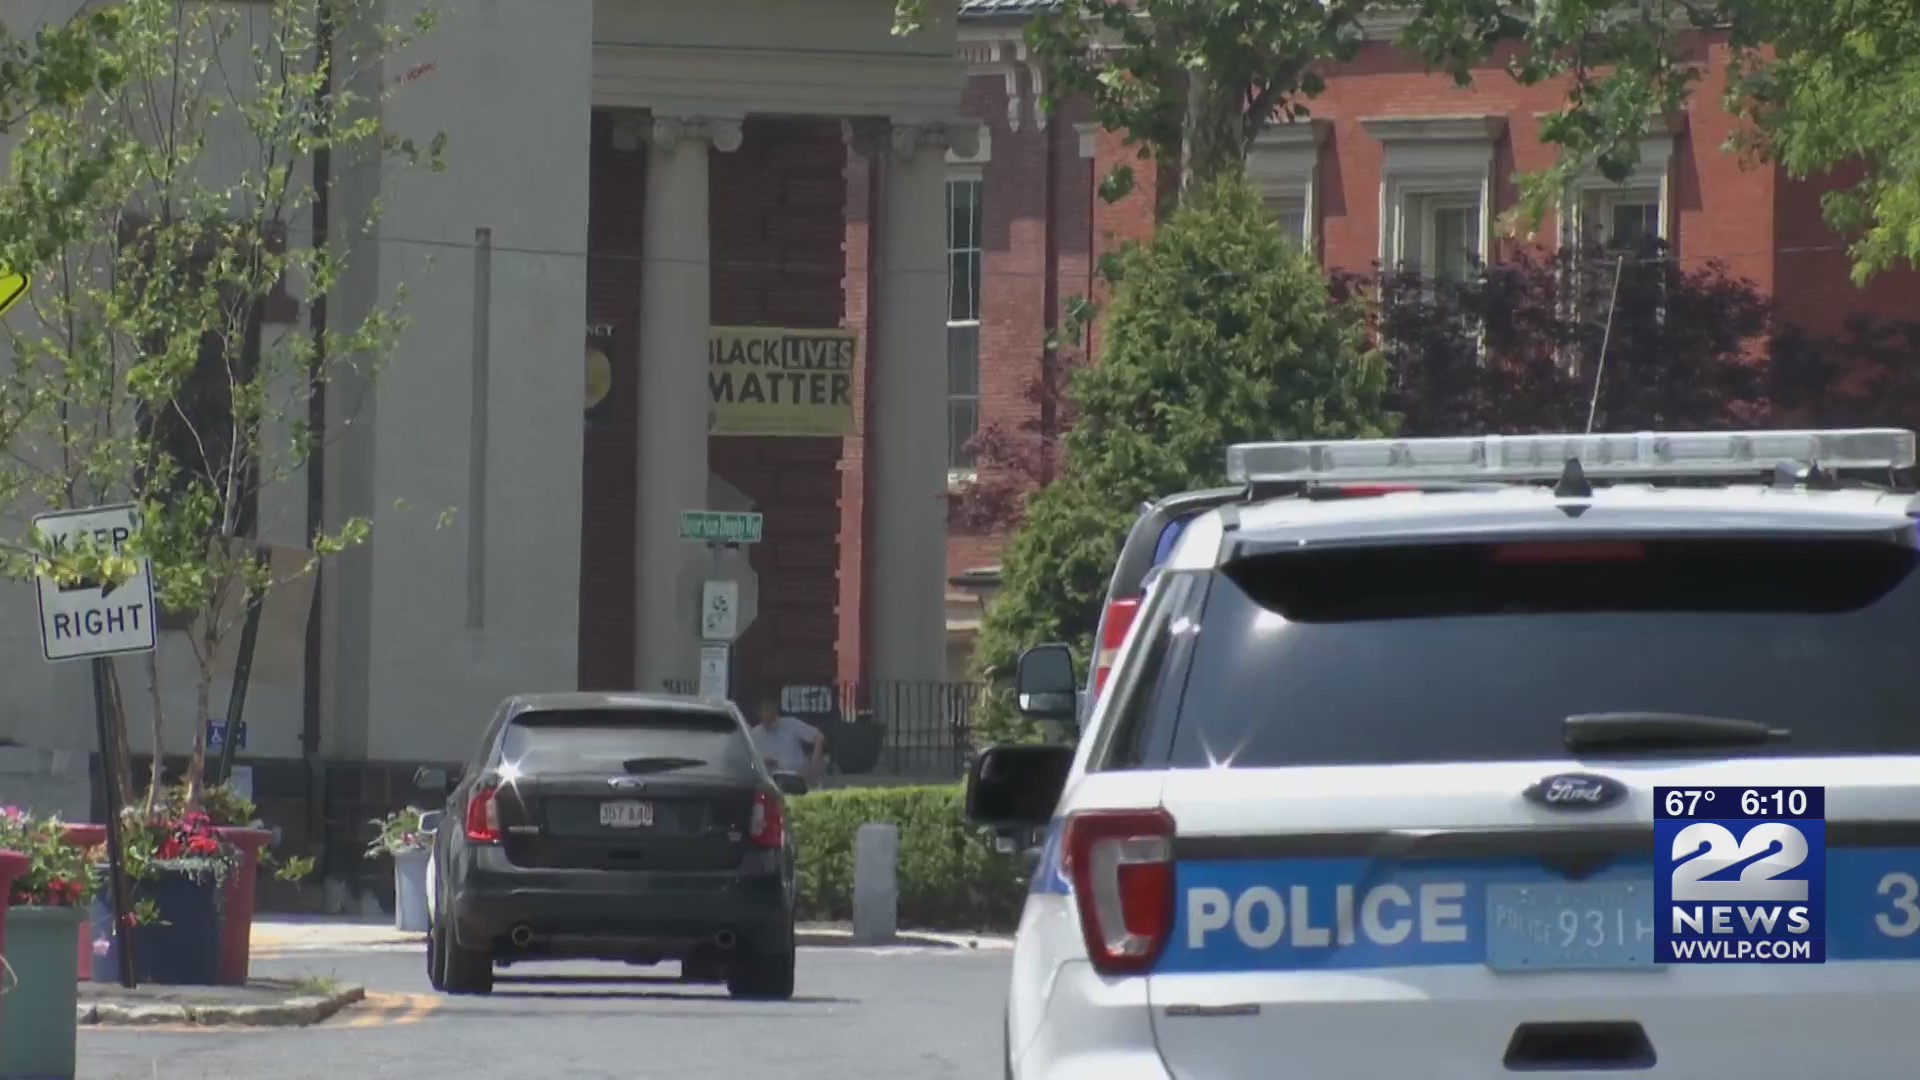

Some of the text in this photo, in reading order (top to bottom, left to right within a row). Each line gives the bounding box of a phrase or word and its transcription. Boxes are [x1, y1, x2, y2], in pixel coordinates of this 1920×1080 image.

[785, 338, 854, 369] LIVES
[708, 371, 852, 406] MATTER
[53, 526, 129, 553] KEP
[53, 603, 144, 640] RIGHT
[1187, 884, 1468, 949] POLICE
[1875, 872, 1920, 938] 3
